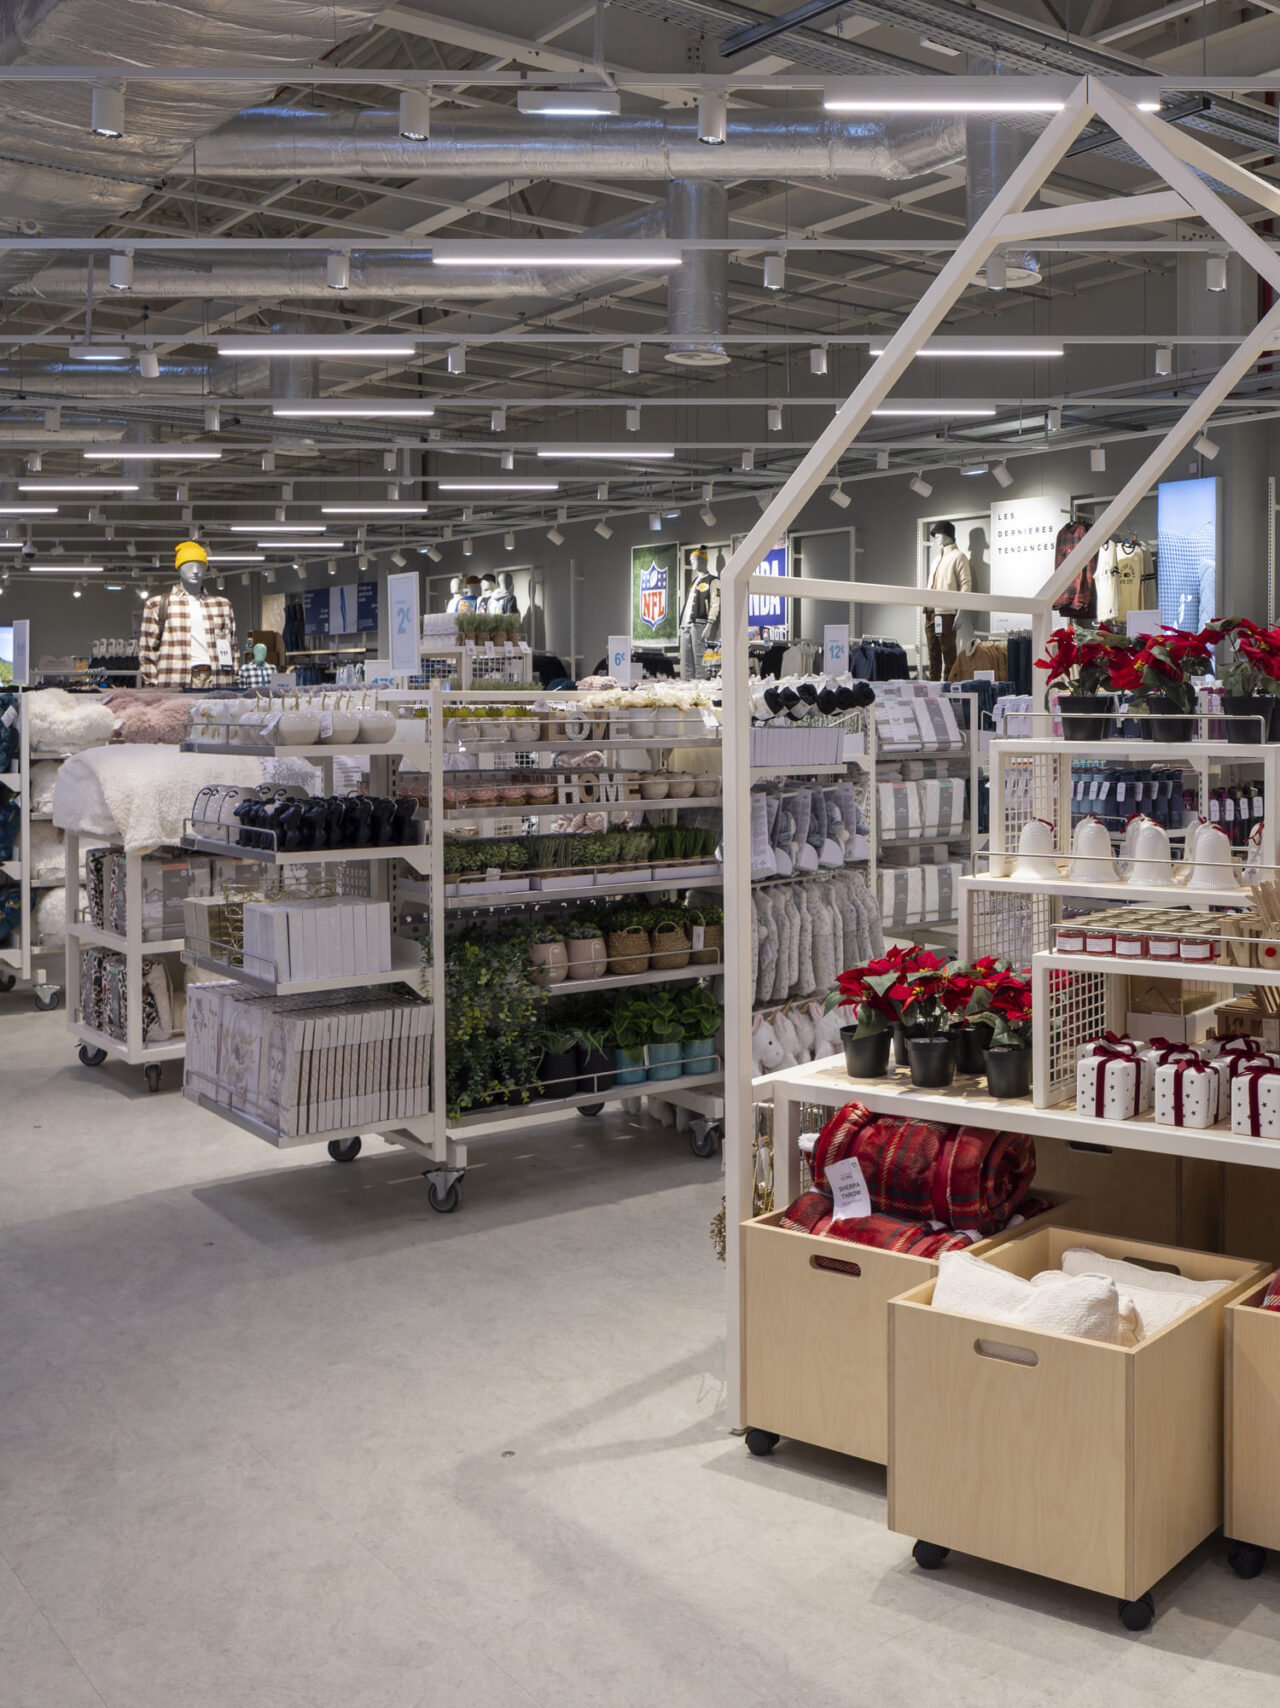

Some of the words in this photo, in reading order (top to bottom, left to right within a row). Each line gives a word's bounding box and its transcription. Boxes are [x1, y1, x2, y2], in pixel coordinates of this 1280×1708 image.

[998, 512, 1015, 521] LES
[998, 542, 1055, 554] TENDANCES
[642, 591, 665, 620] NFL
[829, 644, 846, 659] 12€
[614, 652, 626, 666] 6€
[557, 772, 641, 804] HOME
[839, 1183, 860, 1192] SHERPA
[842, 1191, 861, 1199] THROW
